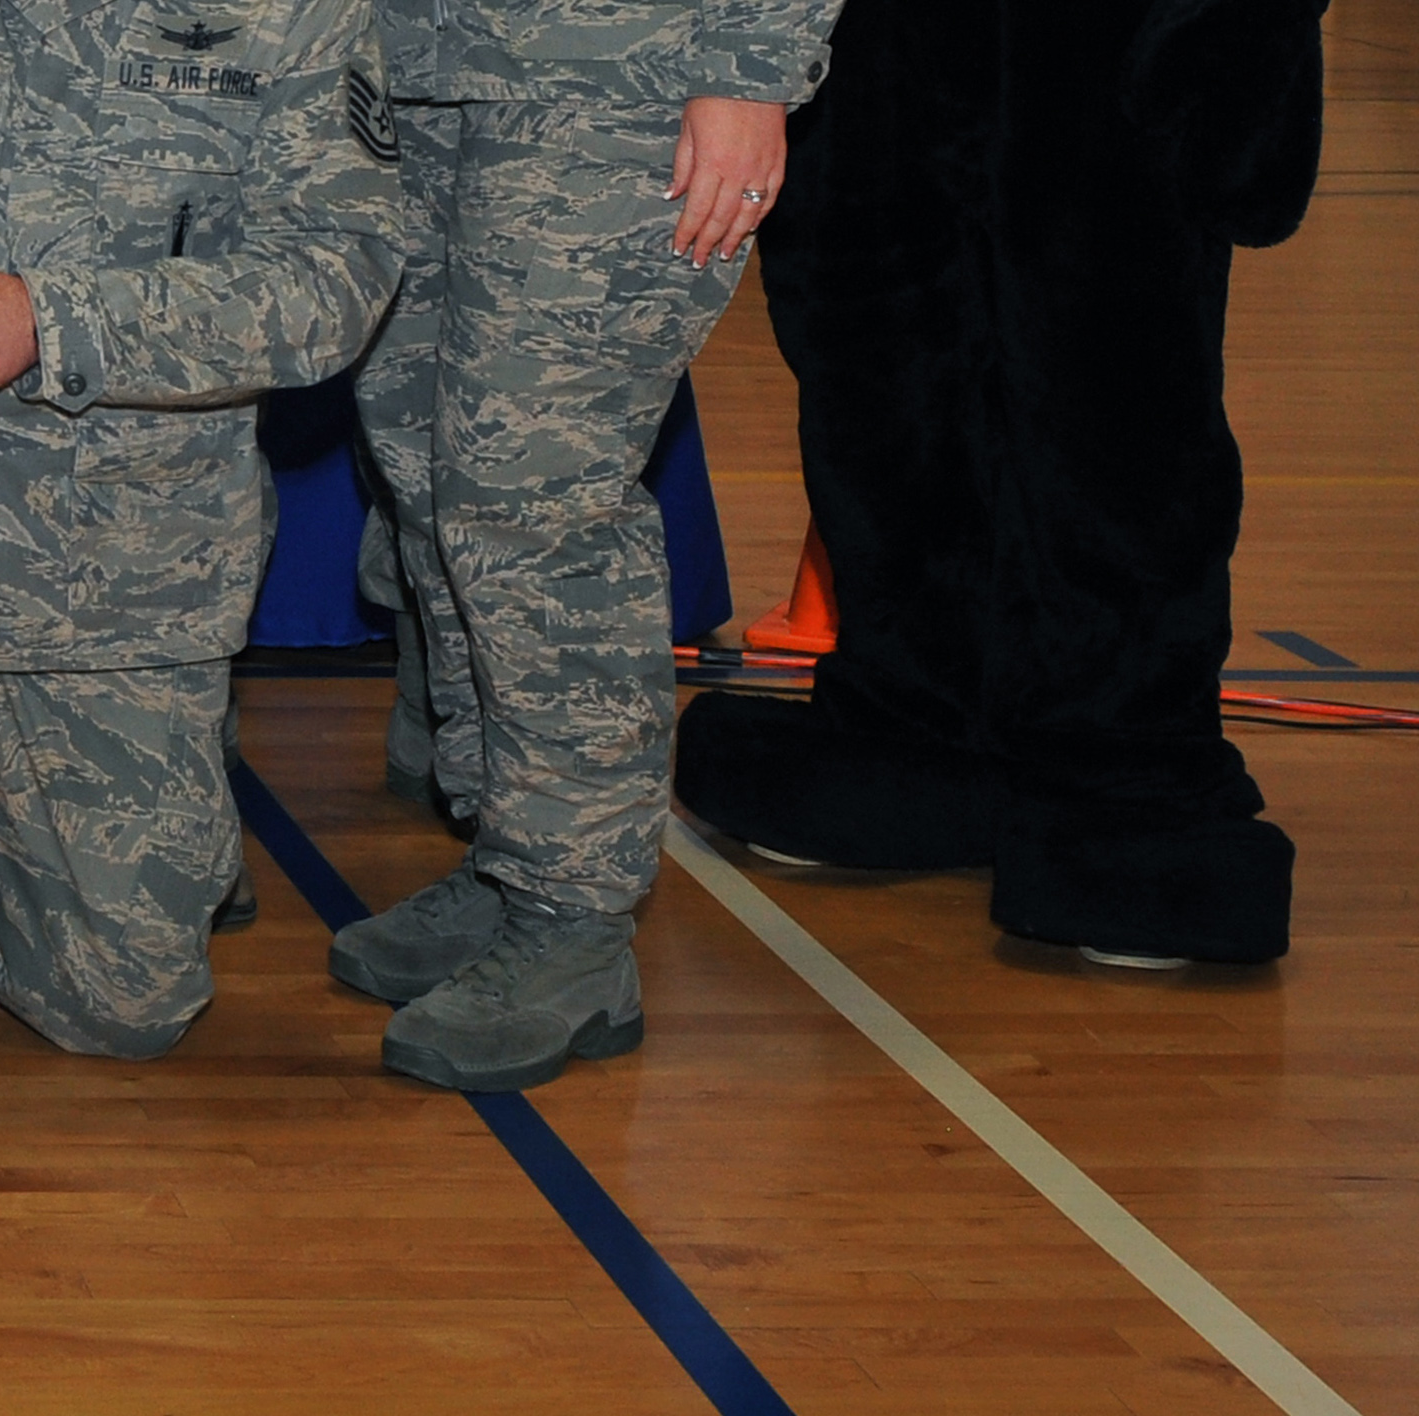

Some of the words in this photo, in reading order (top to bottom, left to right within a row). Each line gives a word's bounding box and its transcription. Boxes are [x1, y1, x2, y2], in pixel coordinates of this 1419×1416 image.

[119, 62, 159, 88] U.S.
[167, 65, 201, 90] AIR
[208, 67, 262, 96] FORCE
